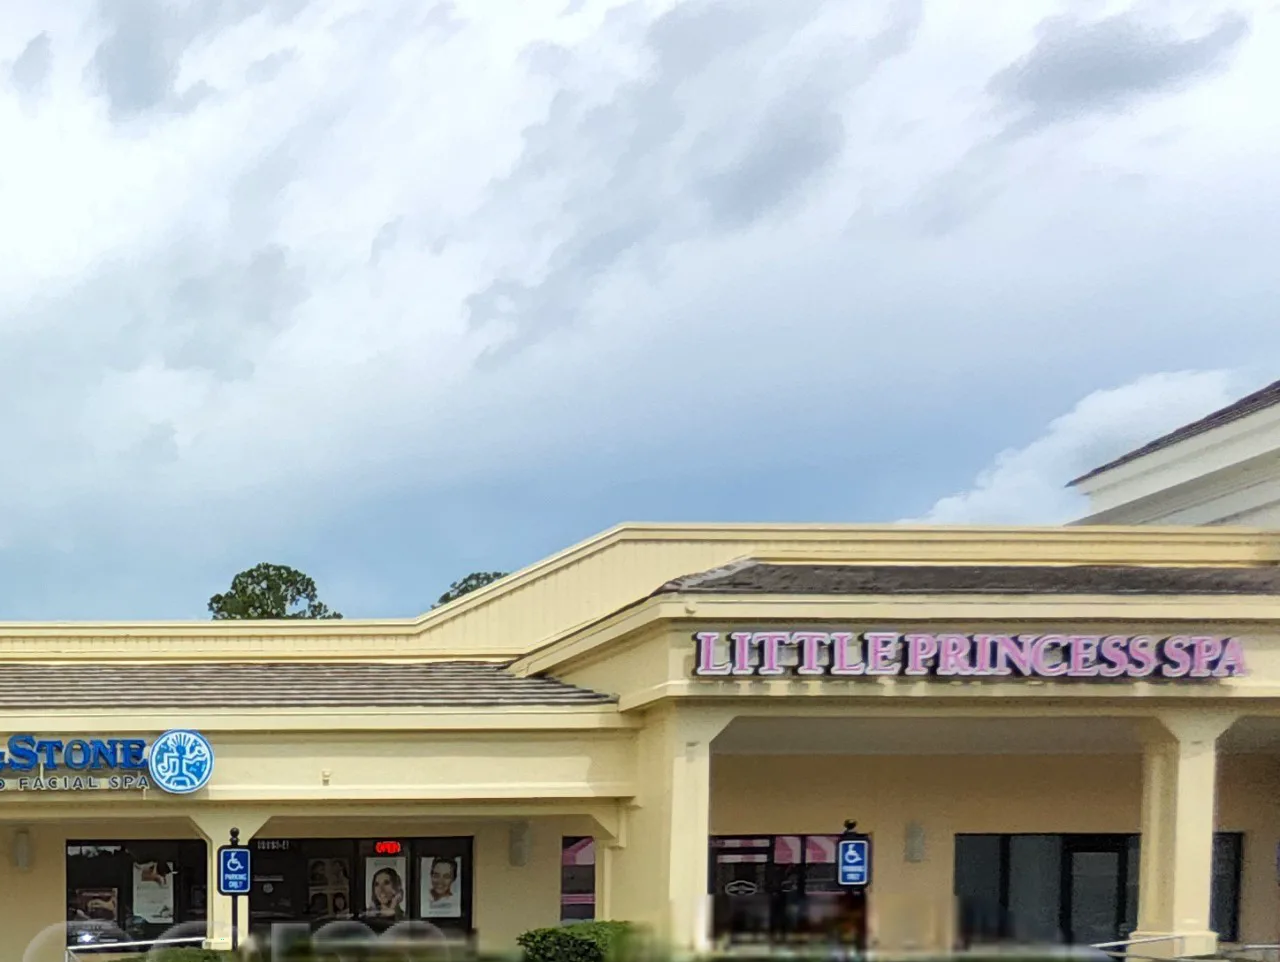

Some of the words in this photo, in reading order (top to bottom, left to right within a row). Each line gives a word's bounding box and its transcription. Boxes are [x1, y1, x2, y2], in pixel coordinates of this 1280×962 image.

[696, 631, 902, 676] LITTLE
[904, 633, 1157, 677] PRINCESS
[1161, 635, 1248, 677] SPA
[18, 775, 100, 792] FACIAL
[108, 774, 150, 791] SPA
